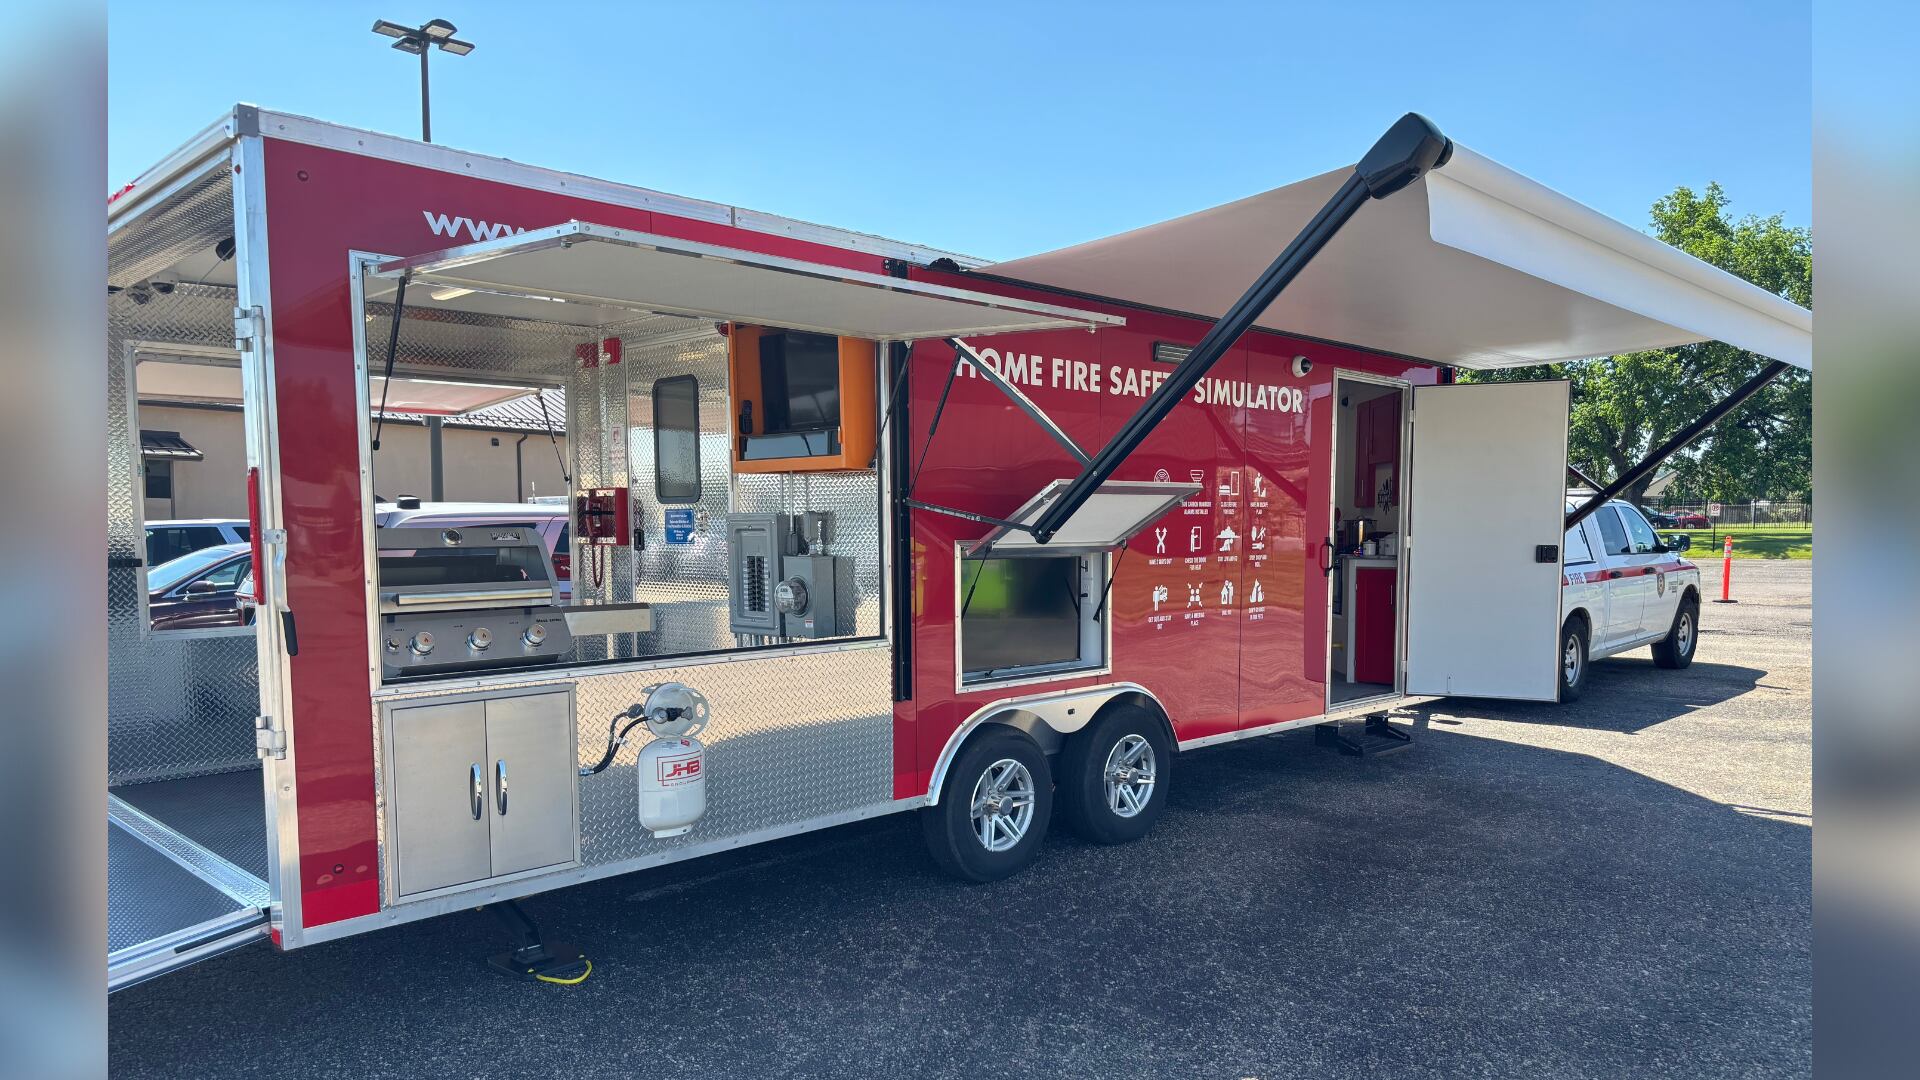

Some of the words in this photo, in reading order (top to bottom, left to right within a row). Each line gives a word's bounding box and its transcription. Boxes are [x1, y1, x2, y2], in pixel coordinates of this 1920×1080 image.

[956, 346, 1043, 387] HOME
[1052, 358, 1101, 393] FIRE
[1109, 365, 1173, 398] SAFE
[1193, 376, 1304, 414] SIMULATOR
[1568, 572, 1585, 586] FIRE
